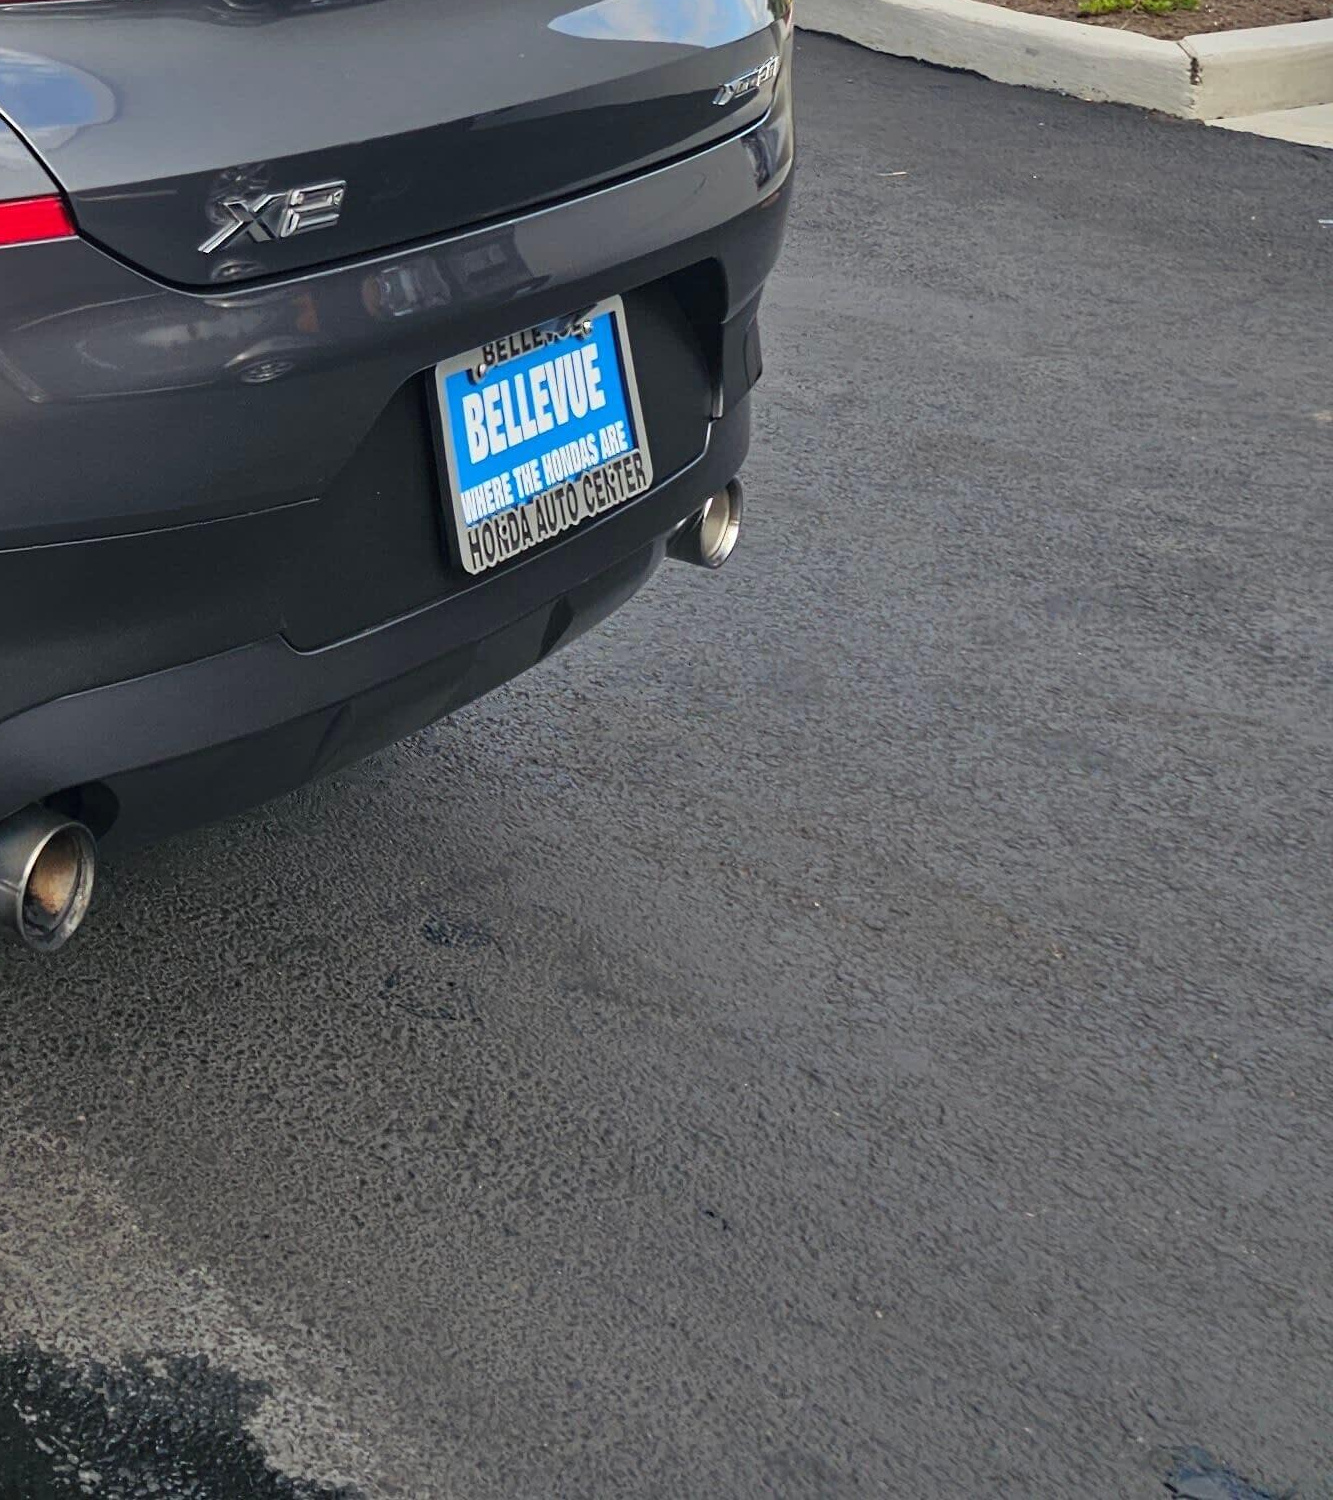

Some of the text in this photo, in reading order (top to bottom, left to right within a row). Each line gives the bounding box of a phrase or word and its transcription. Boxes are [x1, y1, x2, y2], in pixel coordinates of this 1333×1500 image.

[198, 180, 347, 254] X2
[483, 320, 586, 366] BELLE
[462, 343, 607, 465] BELLEVUE
[461, 420, 629, 525] WHERE THE HONDAS ARE
[468, 453, 647, 569] HONDA AUTO CENTER
